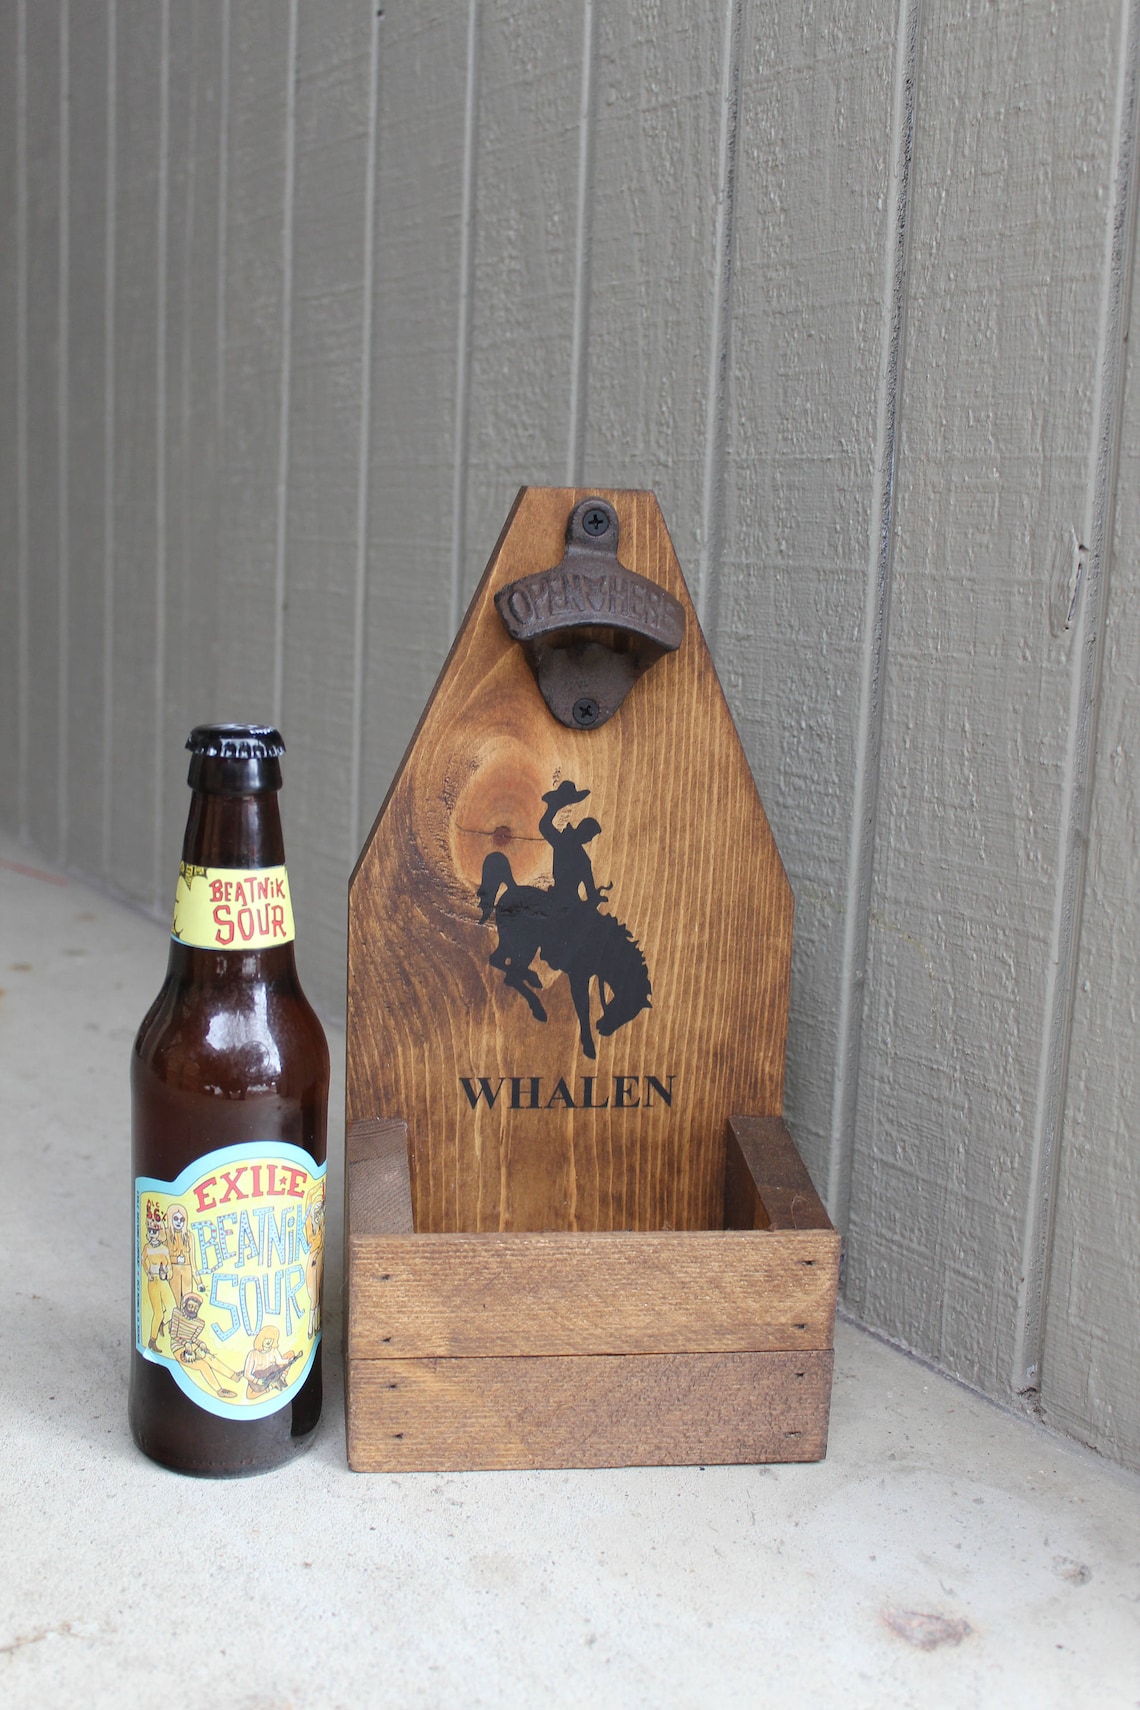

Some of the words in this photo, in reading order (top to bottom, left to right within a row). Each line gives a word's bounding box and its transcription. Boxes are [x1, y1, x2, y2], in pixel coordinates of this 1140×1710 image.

[213, 903, 287, 945] SOUR
[459, 1075, 677, 1110] WHALEN
[193, 1164, 308, 1213] EXILE
[209, 1264, 306, 1342] SOUR
